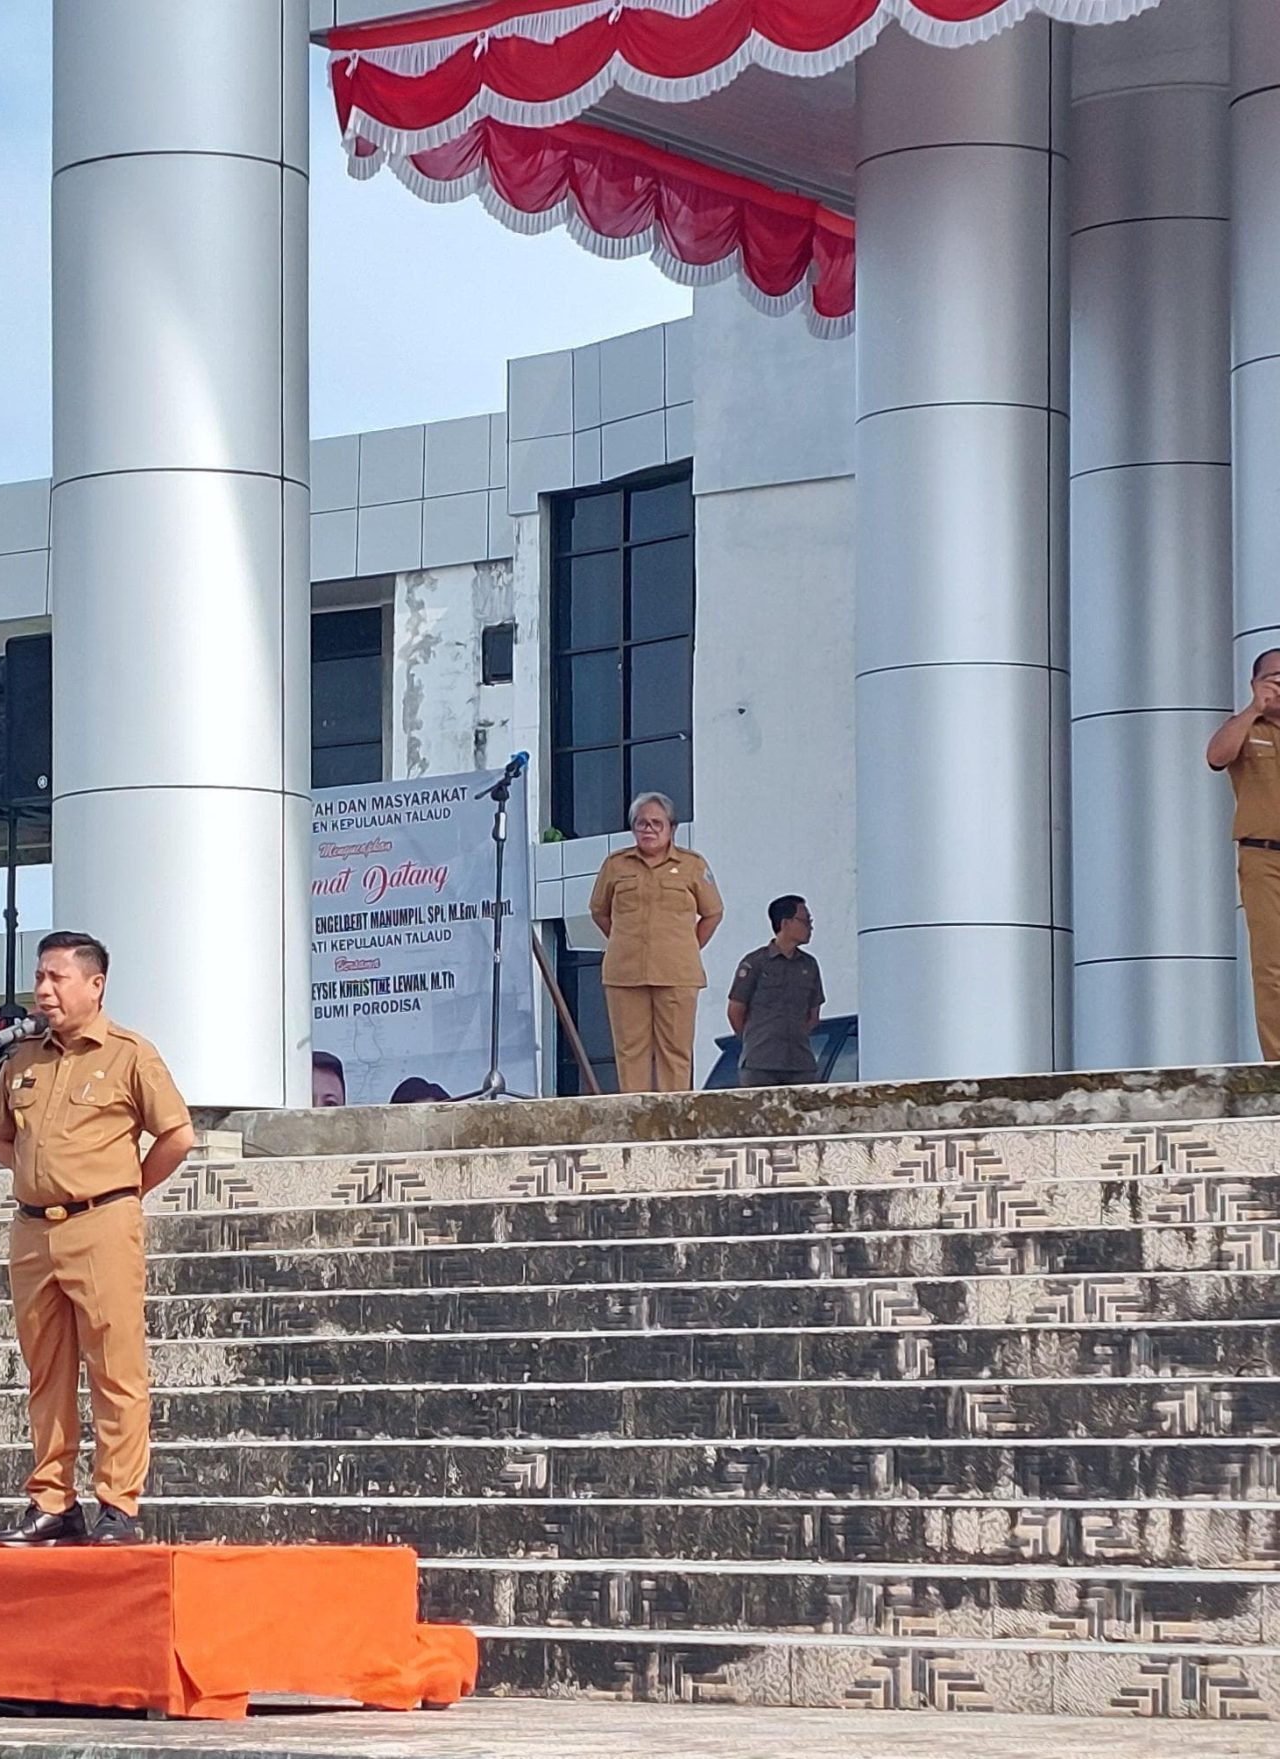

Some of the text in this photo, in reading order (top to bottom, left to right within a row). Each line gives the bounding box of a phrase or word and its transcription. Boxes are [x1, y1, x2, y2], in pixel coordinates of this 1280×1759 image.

[312, 787, 468, 817] AH DAN MASYARAKAT
[331, 812, 402, 831] KEPULAUAN
[405, 807, 452, 823] TALAUD
[362, 861, 449, 905] Datang
[315, 912, 369, 934] ENGELBERT
[331, 931, 402, 952] KEPULAUAN
[405, 929, 452, 945] TALAUD
[314, 998, 422, 1020] BUMI PORODISA
